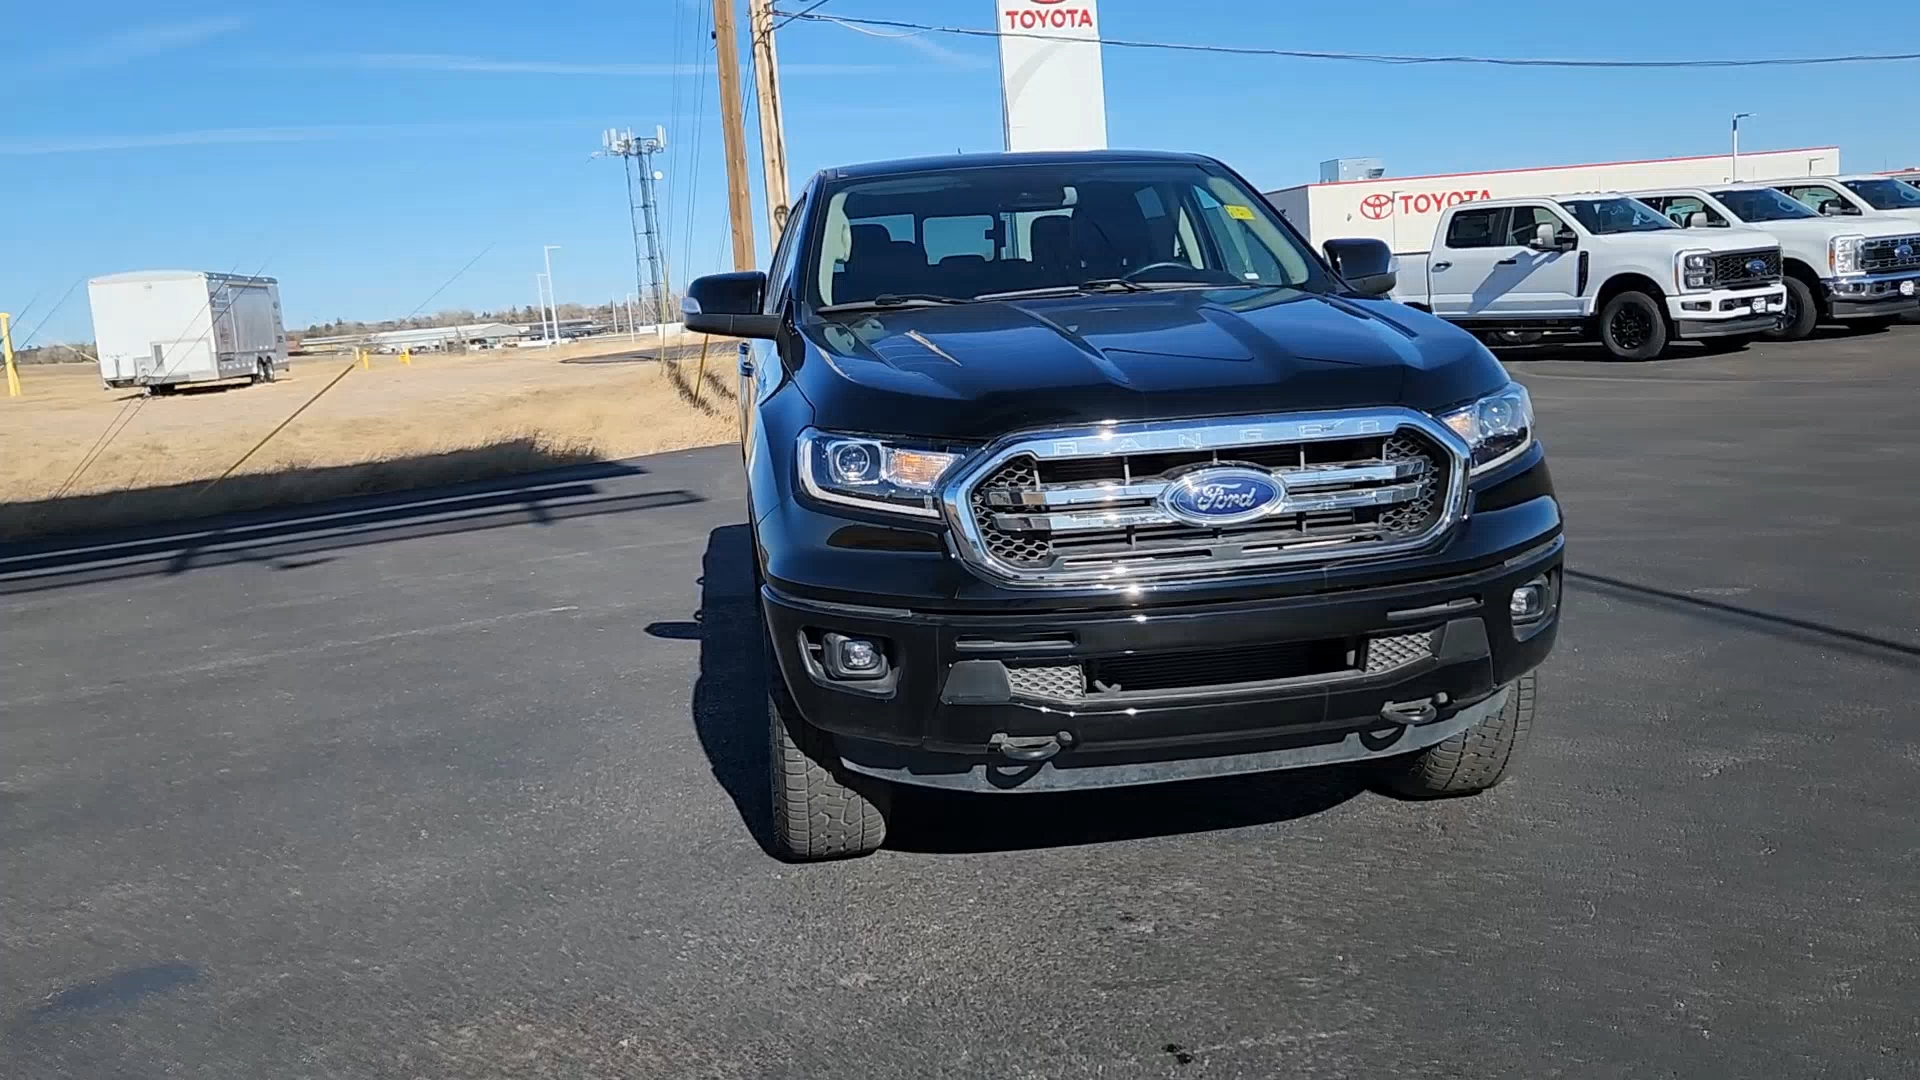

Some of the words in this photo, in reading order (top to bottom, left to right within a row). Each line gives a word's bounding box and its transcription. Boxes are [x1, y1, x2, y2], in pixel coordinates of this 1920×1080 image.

[1005, 9, 1093, 29] TOYOTA
[1053, 420, 1379, 456] RANGER
[1198, 483, 1257, 511] Ford
